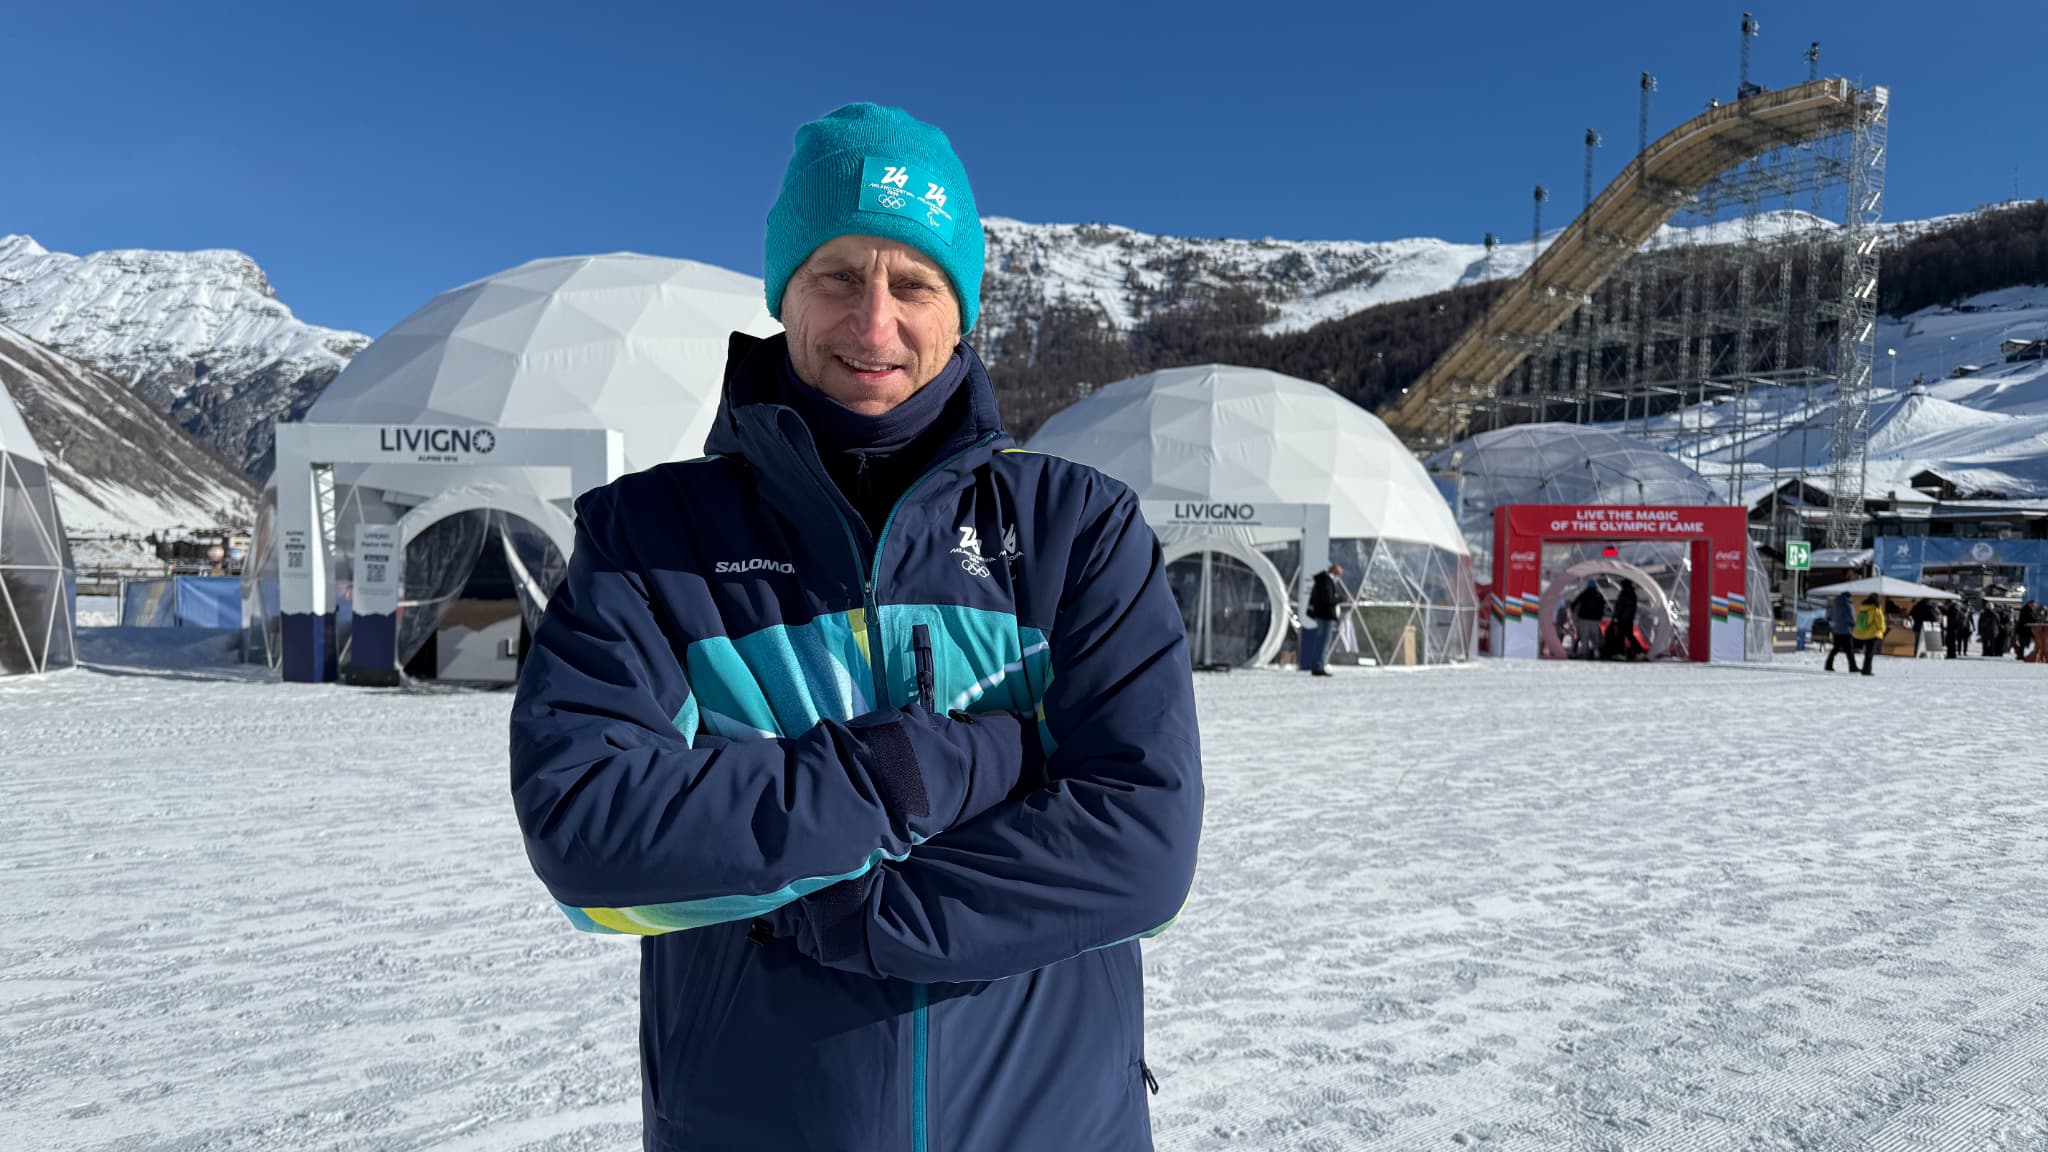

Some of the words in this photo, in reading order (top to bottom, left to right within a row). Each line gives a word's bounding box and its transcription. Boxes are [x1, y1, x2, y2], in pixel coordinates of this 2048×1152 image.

[380, 428, 496, 454] LIVIGNO
[1175, 503, 1255, 520] LIVIGNO
[1576, 509, 1605, 520] LIVE
[1608, 510, 1633, 520] THE
[1636, 510, 1679, 521] MAGIC
[1551, 520, 1569, 531] OF
[1571, 520, 1597, 531] THE
[1599, 520, 1657, 532] OLYMPIC
[1659, 521, 1704, 532] FLAME
[715, 558, 795, 574] SALOMO
